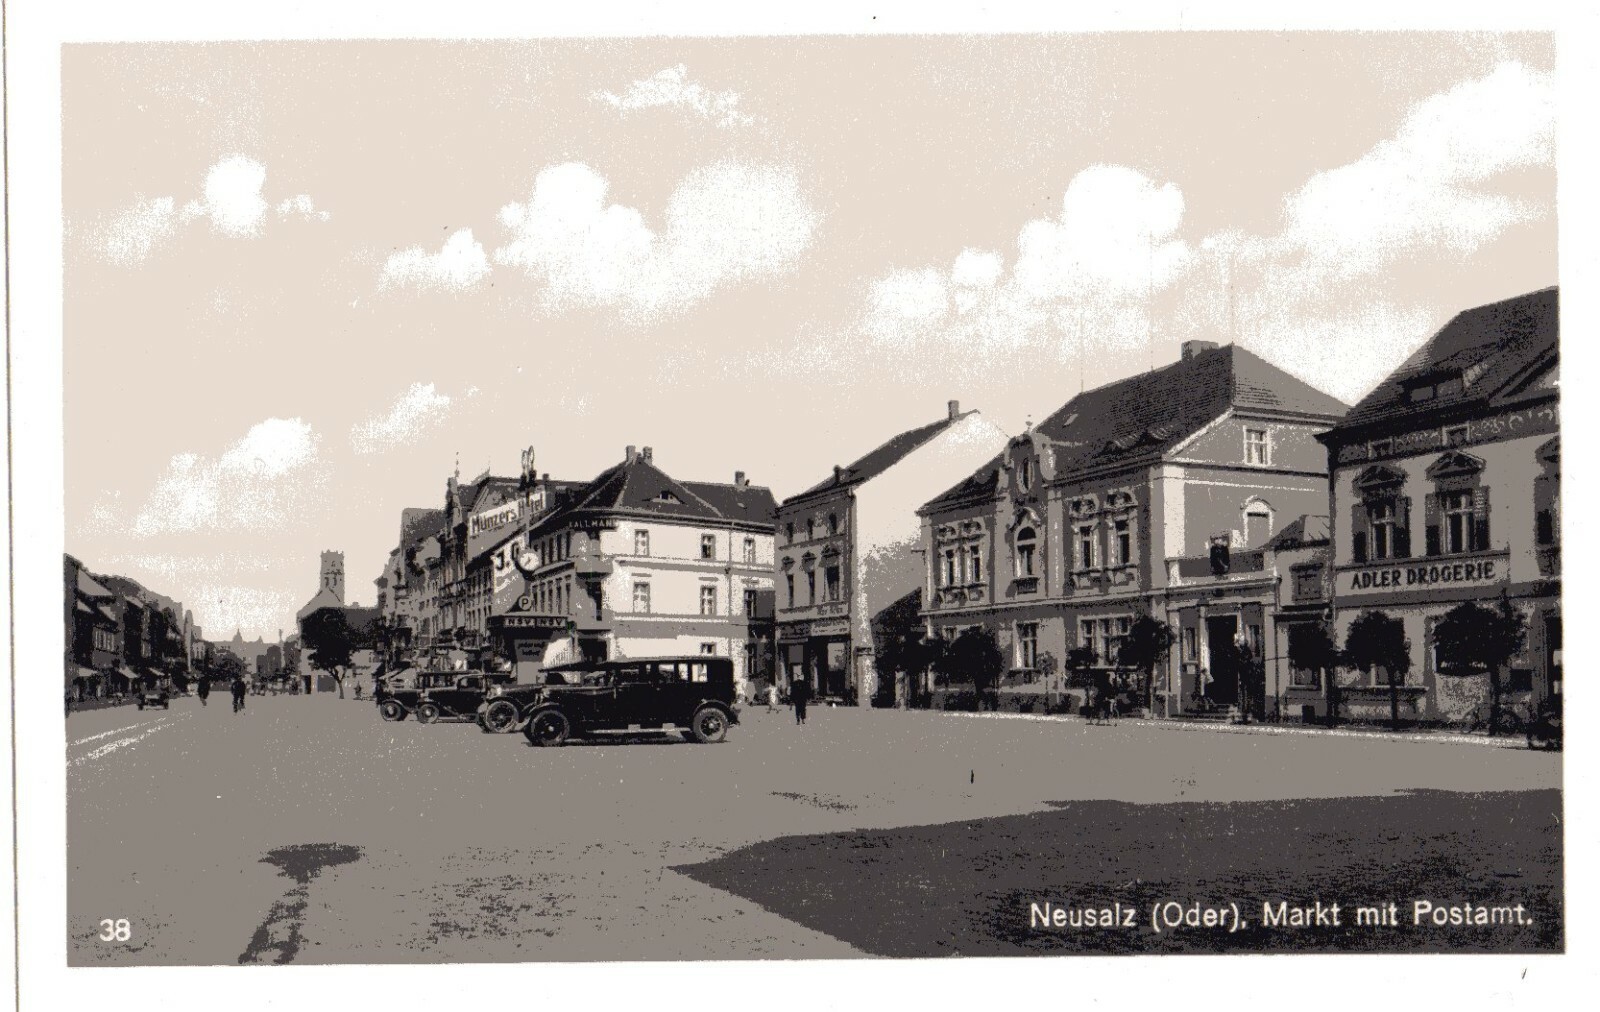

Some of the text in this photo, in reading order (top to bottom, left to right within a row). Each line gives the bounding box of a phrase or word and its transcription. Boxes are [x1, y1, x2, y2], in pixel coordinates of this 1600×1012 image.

[472, 492, 544, 537] Münzers Htel
[1351, 561, 1496, 590] ADLER DROGERIE
